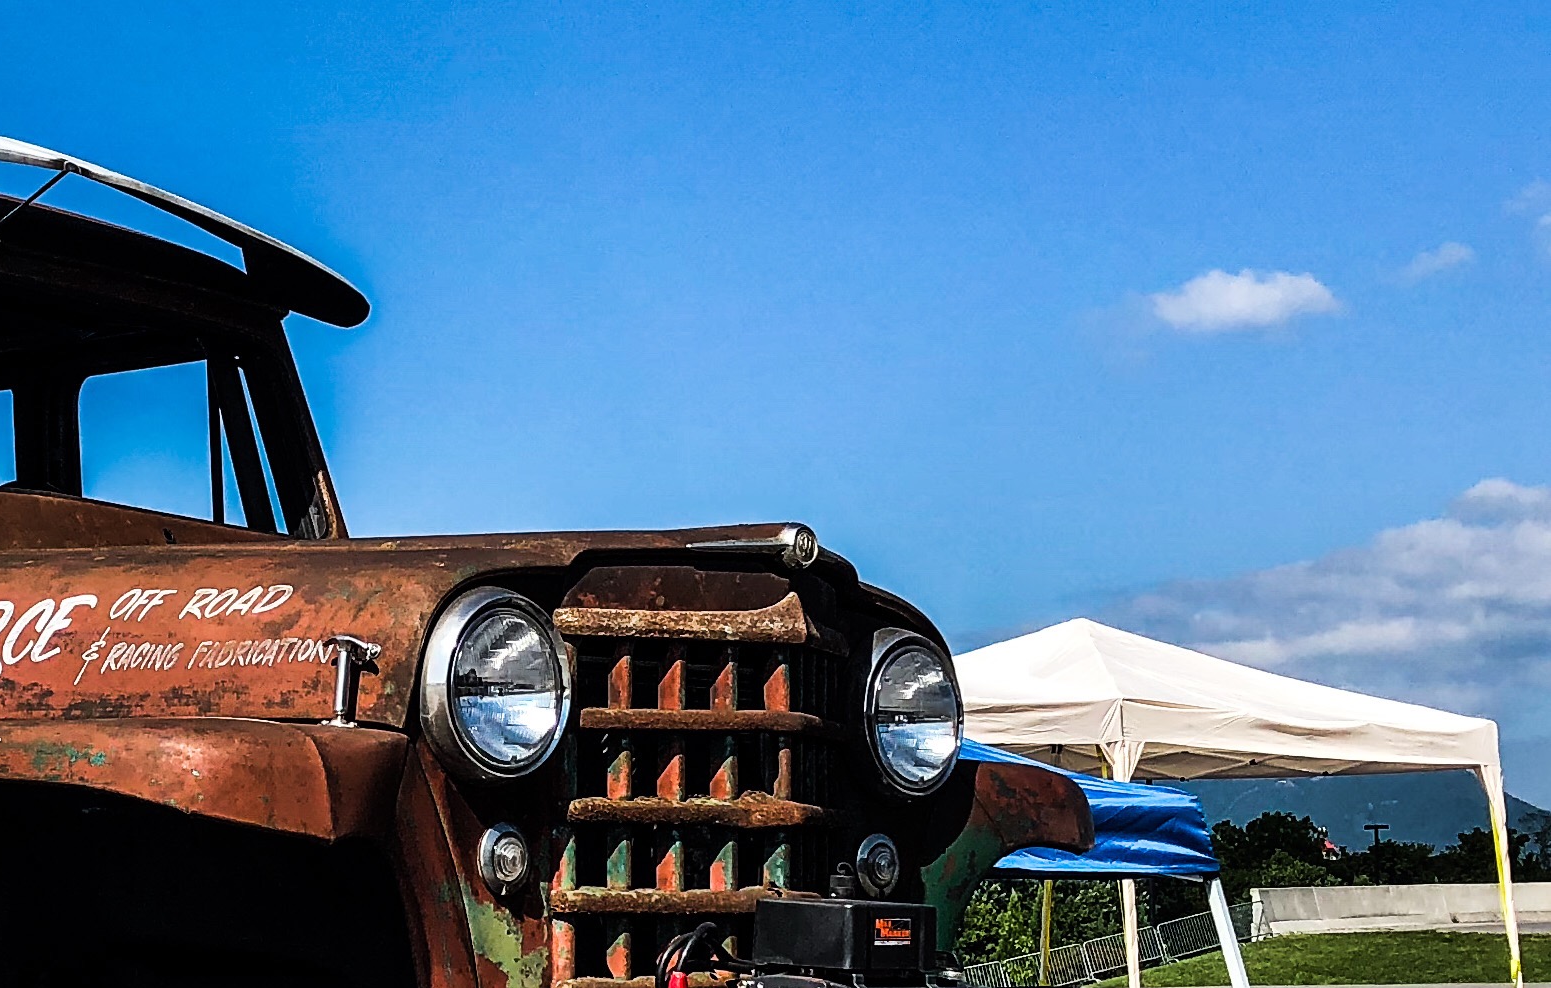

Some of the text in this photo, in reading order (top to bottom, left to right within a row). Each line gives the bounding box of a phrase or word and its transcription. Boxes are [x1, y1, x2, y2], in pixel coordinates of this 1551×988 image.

[109, 584, 294, 623] OFF ROAD
[99, 640, 184, 675] RACING
[187, 636, 336, 671] FABRICATION
